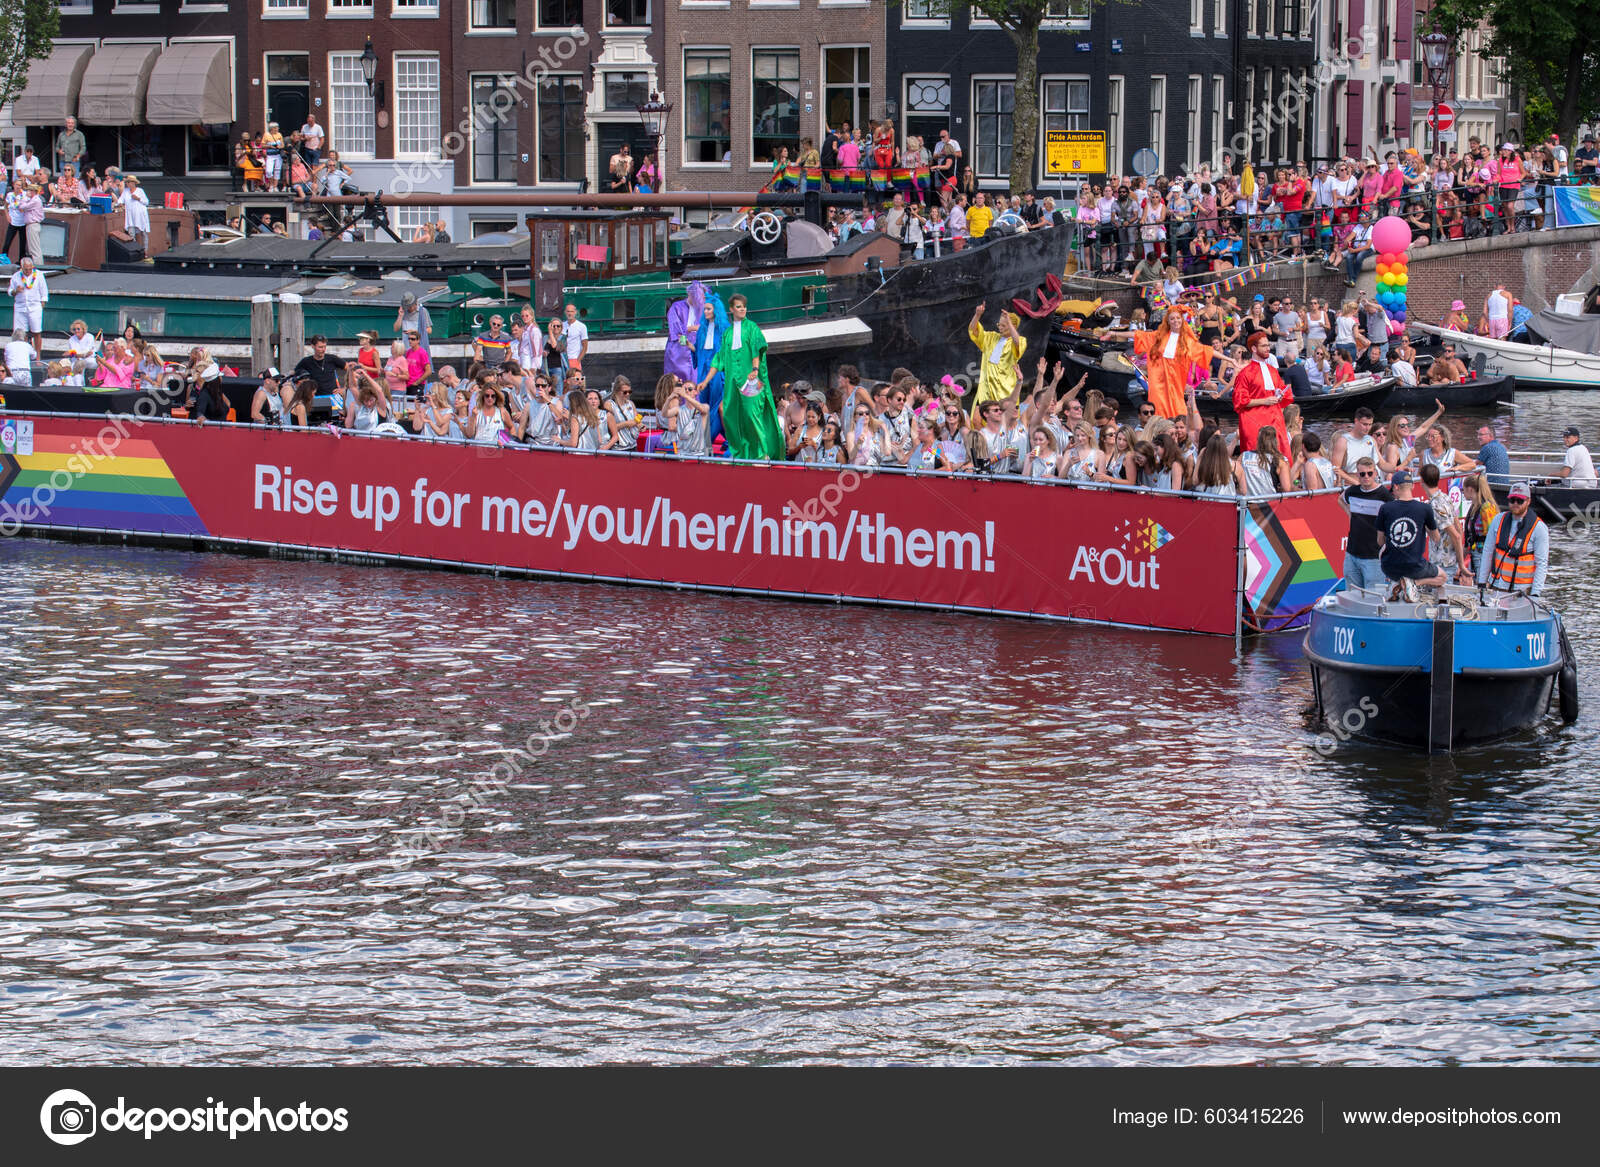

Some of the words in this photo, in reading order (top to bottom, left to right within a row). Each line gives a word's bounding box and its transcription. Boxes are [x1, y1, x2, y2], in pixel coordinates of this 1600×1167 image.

[1049, 133, 1066, 141] Pride
[1067, 133, 1103, 141] Amsterdam
[4, 431, 14, 441] 52
[1450, 491, 1460, 503] 52
[253, 463, 339, 517] Rise
[350, 483, 401, 532] up
[410, 477, 471, 529] for
[481, 488, 996, 573] me/you/her/him/them!
[1333, 626, 1355, 656] TOX
[1526, 632, 1546, 661] TOX
